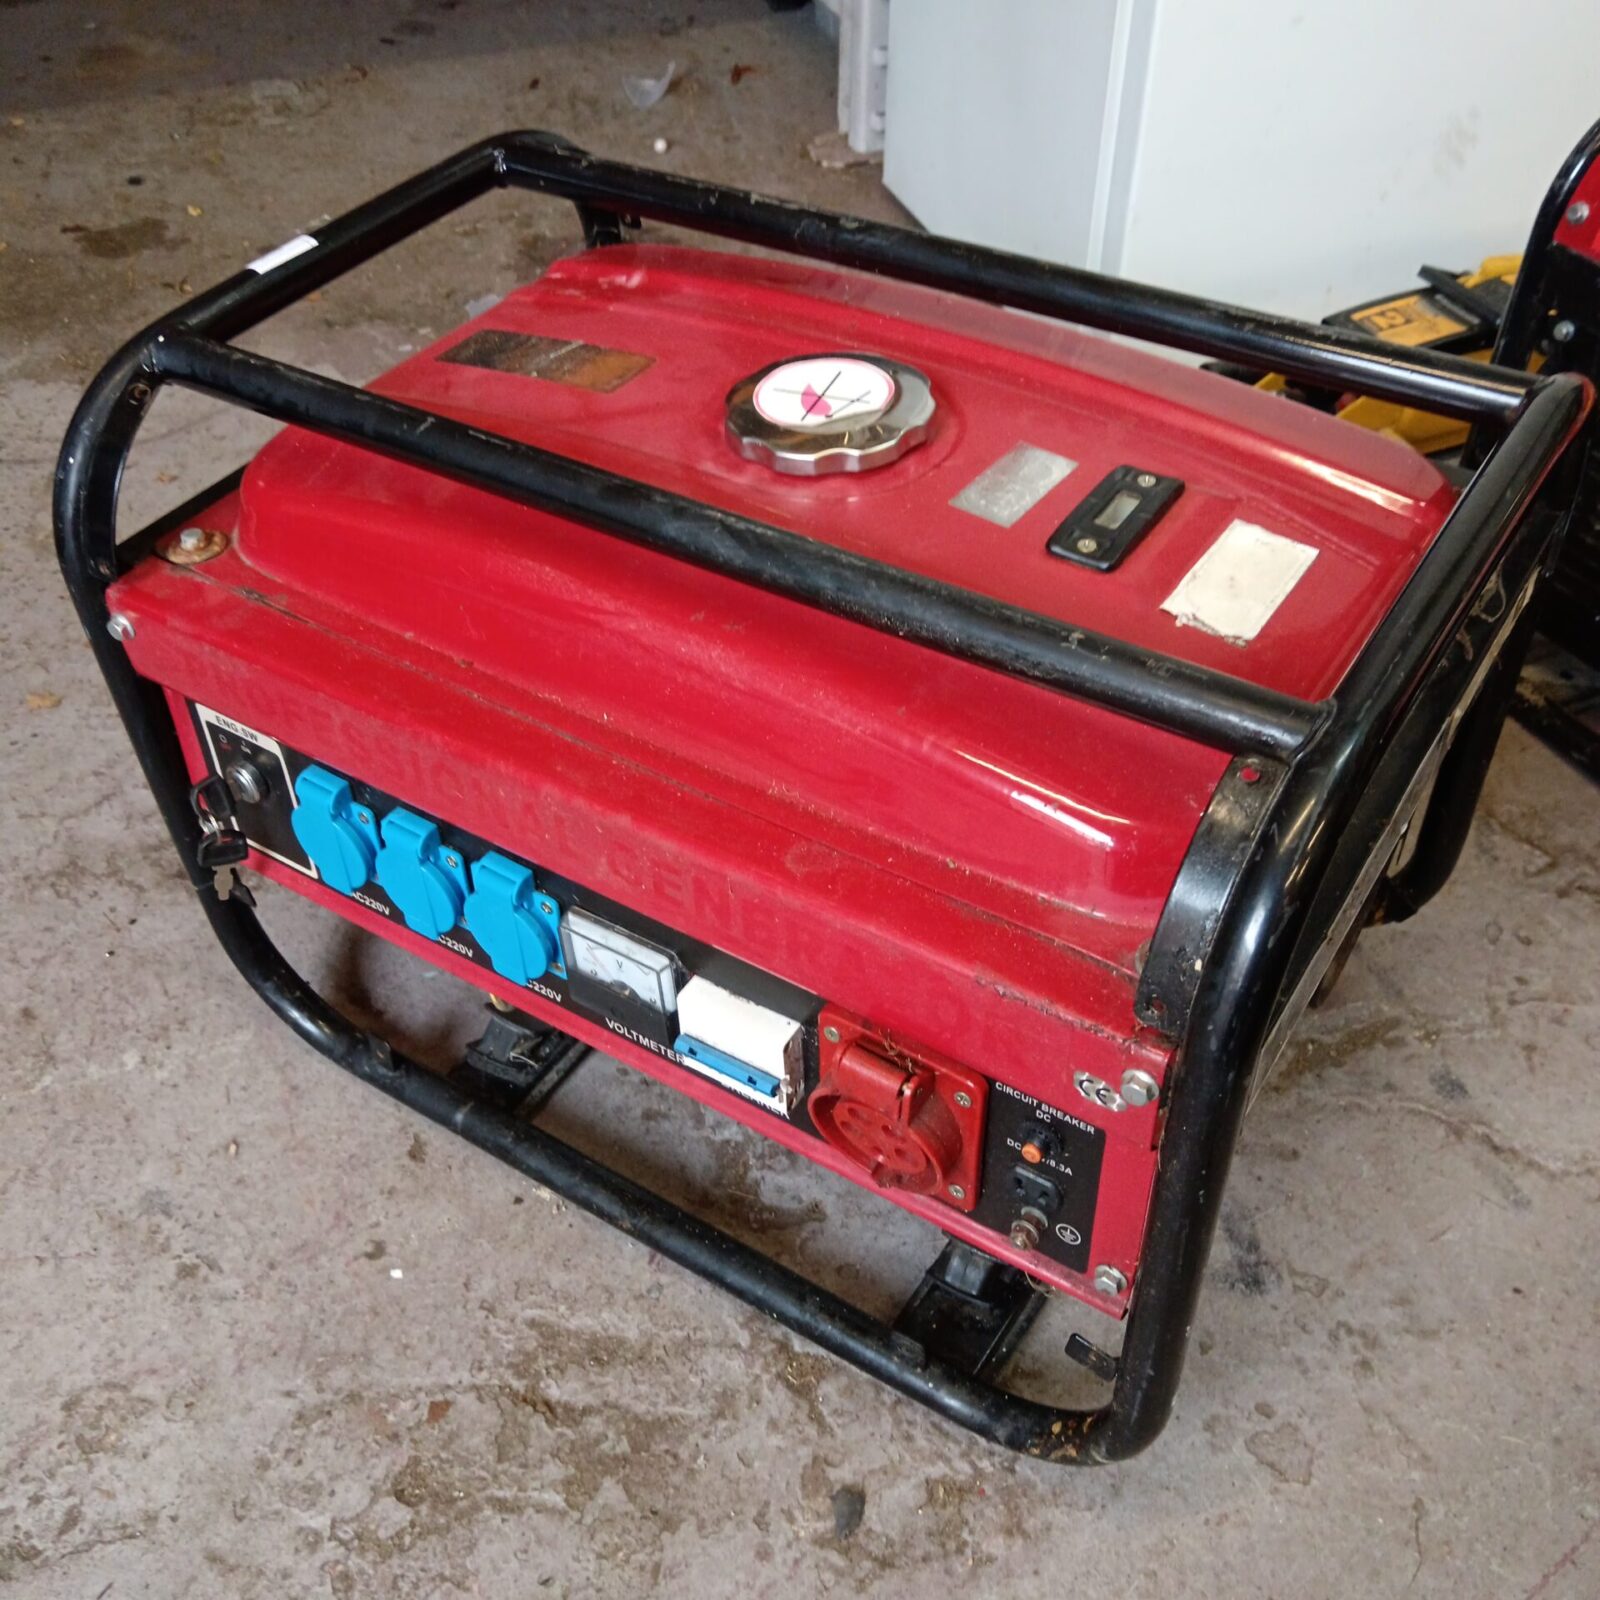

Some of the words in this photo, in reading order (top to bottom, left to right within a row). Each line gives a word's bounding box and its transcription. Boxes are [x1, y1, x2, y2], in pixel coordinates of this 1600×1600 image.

[437, 934, 473, 958] C220V
[605, 1017, 685, 1063] VOLTMETER
[995, 1081, 1039, 1107] CIRCUIT
[1041, 1103, 1095, 1135] BREAKER
[1035, 1110, 1051, 1123] DC
